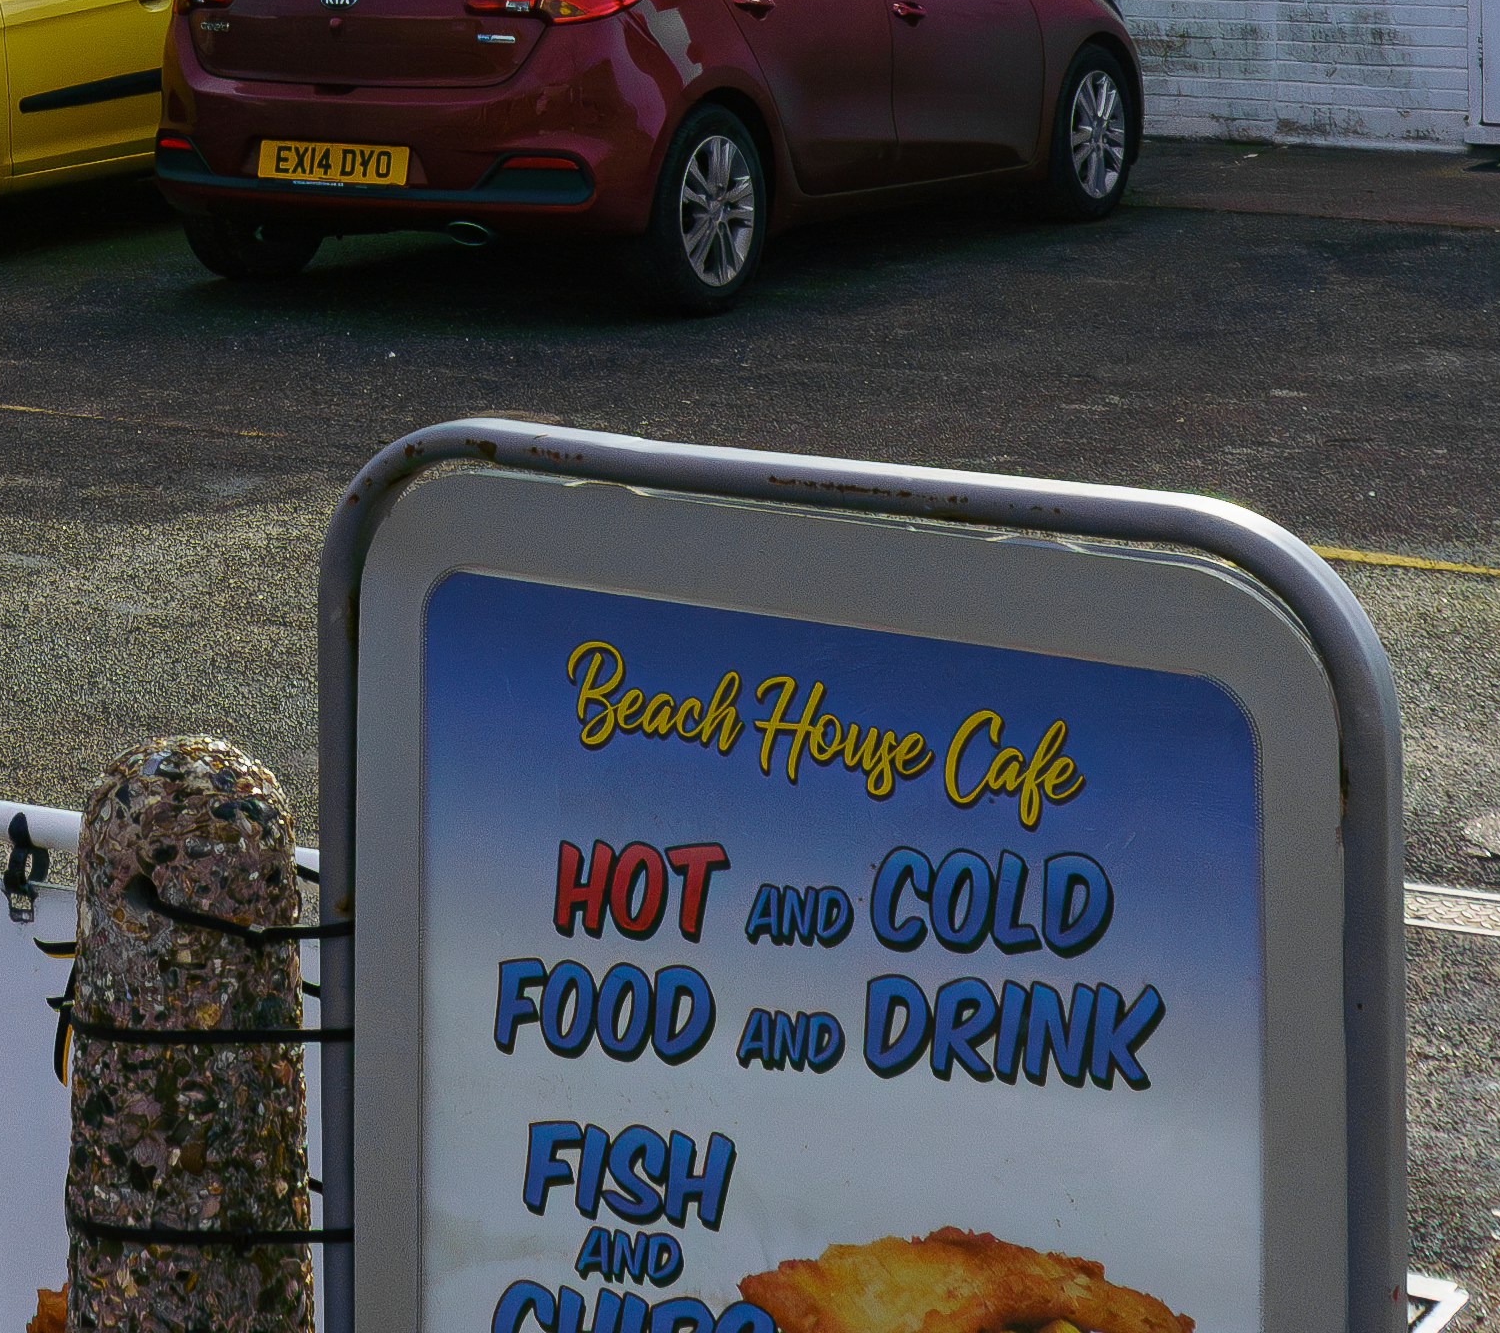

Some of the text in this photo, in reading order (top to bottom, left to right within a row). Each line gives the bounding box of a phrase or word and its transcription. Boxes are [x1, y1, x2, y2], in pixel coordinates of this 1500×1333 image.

[274, 145, 392, 179] EX14 DYO
[565, 640, 1087, 832] Beach House Cafe
[553, 839, 1115, 959] HOT AND COLD
[495, 957, 1167, 1092] FOOD AND DRINK
[522, 1120, 738, 1232] FISH
[574, 1225, 685, 1288] AND
